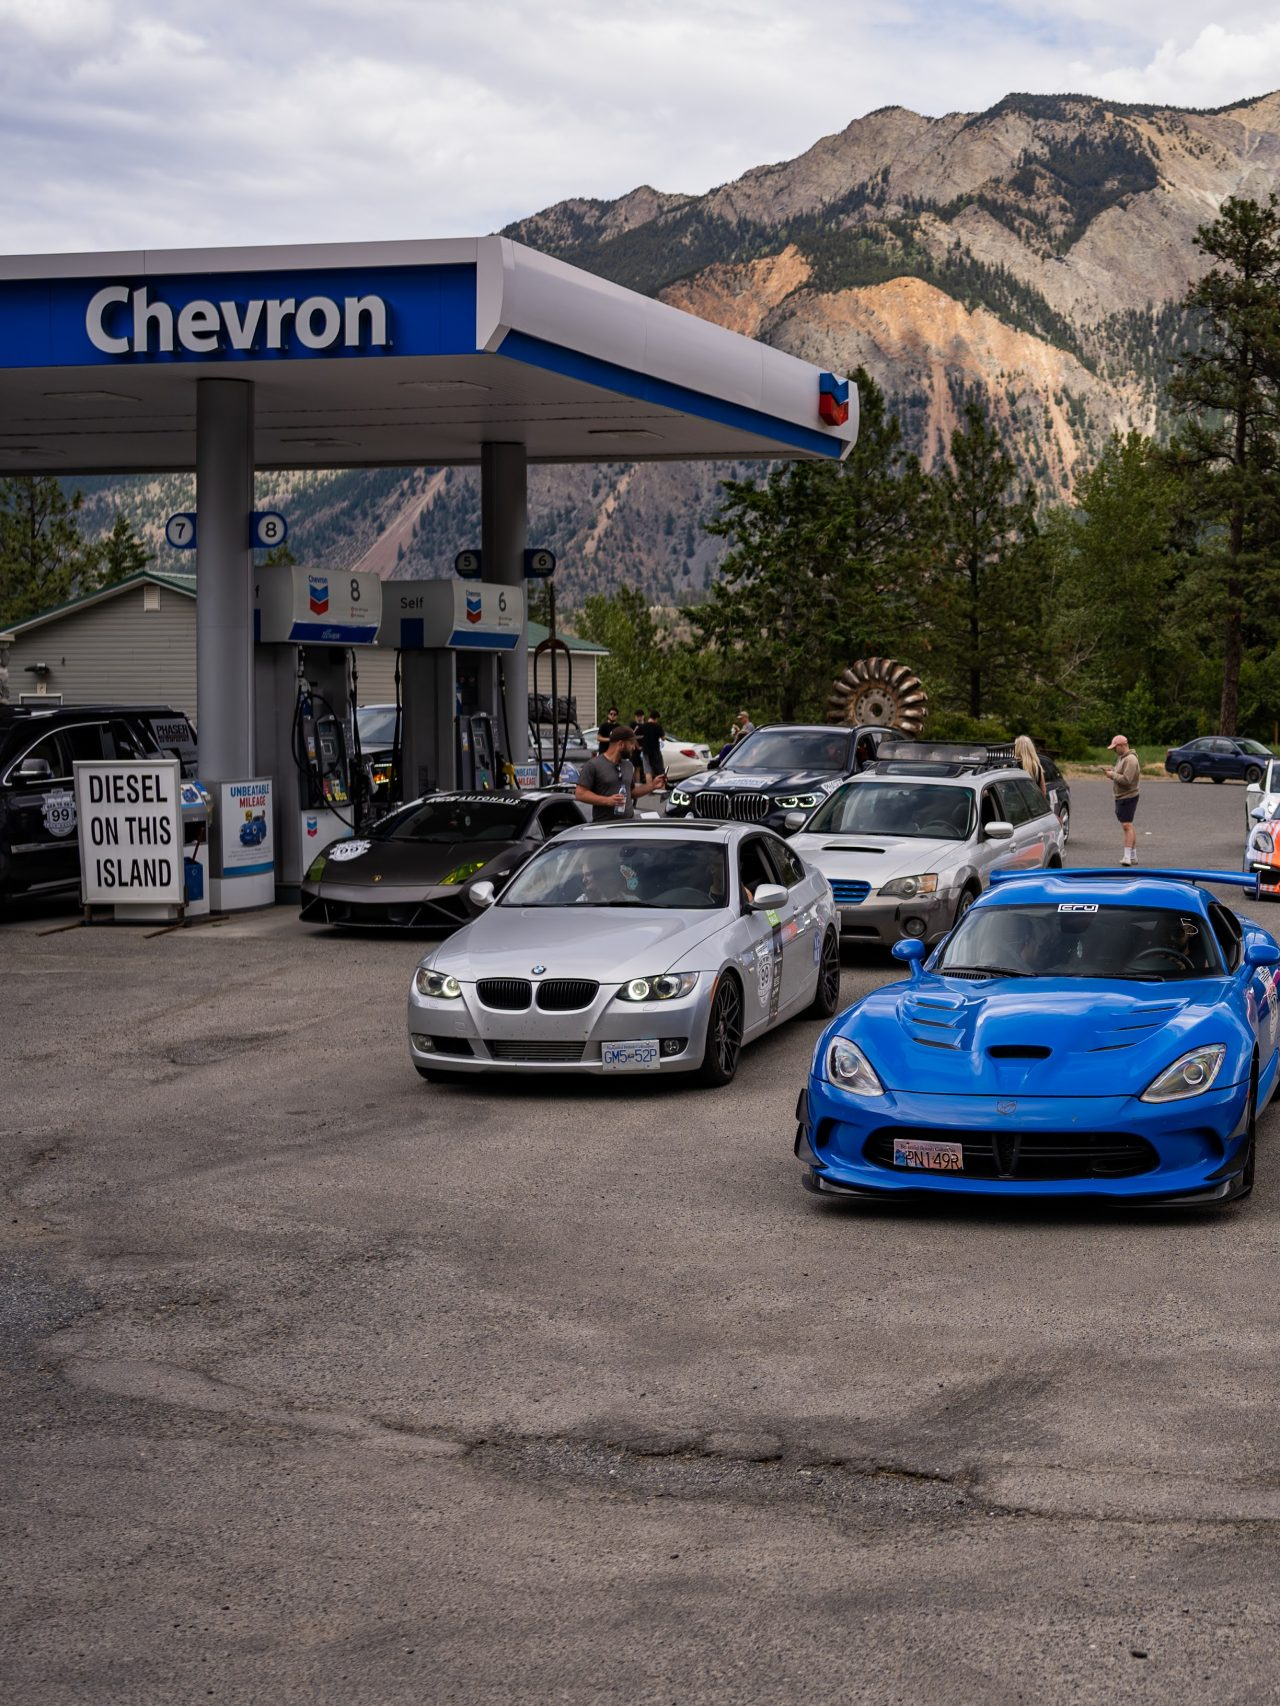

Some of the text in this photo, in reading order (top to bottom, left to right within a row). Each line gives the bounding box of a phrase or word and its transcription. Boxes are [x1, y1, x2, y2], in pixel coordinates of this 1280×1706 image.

[86, 286, 387, 354] Chevron
[176, 523, 185, 538] 7
[265, 521, 277, 537] 8
[464, 556, 471, 567] 5
[539, 555, 547, 566] 6
[308, 575, 328, 584] Chevron
[351, 579, 361, 601] 8
[401, 597, 424, 609] Self
[499, 592, 506, 612] 6
[89, 774, 168, 803] DIESEL
[230, 784, 269, 797] UNBEATABLE
[240, 796, 266, 808] MILEAGE
[52, 808, 69, 822] 99
[91, 816, 171, 846] ON THIS
[96, 858, 171, 888] ISLAND
[1180, 917, 1199, 935] 5
